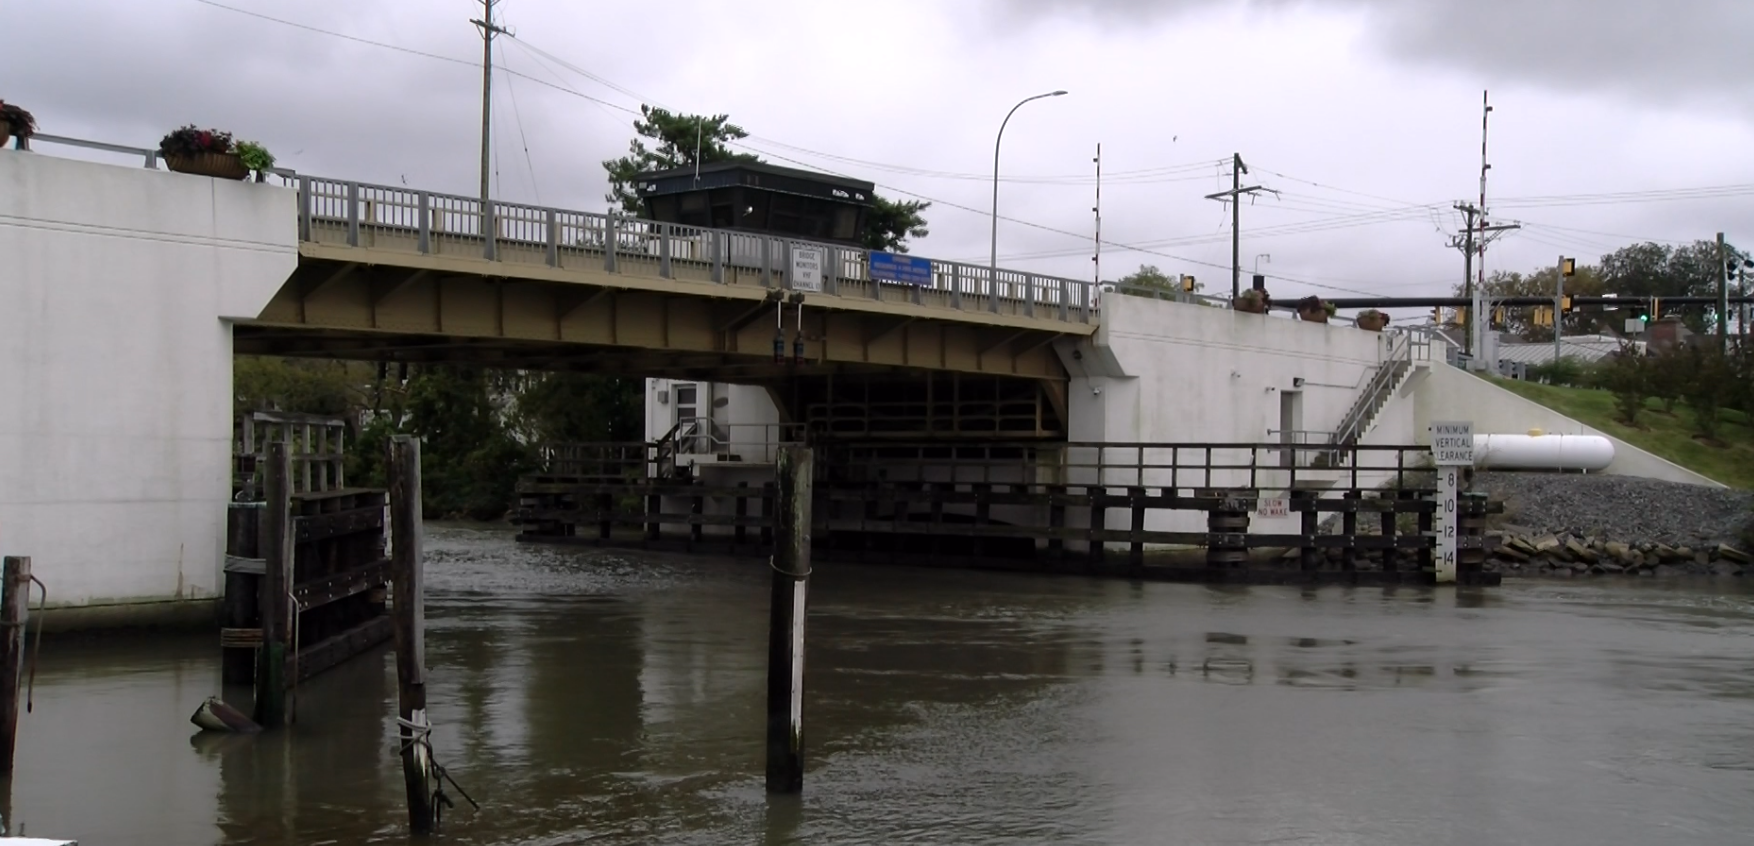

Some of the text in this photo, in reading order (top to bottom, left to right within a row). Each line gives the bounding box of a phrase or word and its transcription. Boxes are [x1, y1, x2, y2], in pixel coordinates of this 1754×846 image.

[799, 251, 815, 260] BRIDGE
[796, 261, 818, 270] MONITORS
[793, 280, 814, 289] CHANNEL
[1436, 425, 1469, 435] MINIMUM
[1435, 437, 1470, 448] VERTICAL
[1448, 473, 1455, 487] 8
[1264, 498, 1282, 507] SLOW
[1444, 499, 1455, 513] 10
[1257, 508, 1287, 516] NO WAKE
[1444, 525, 1455, 539] 12
[1444, 551, 1454, 565] 14
